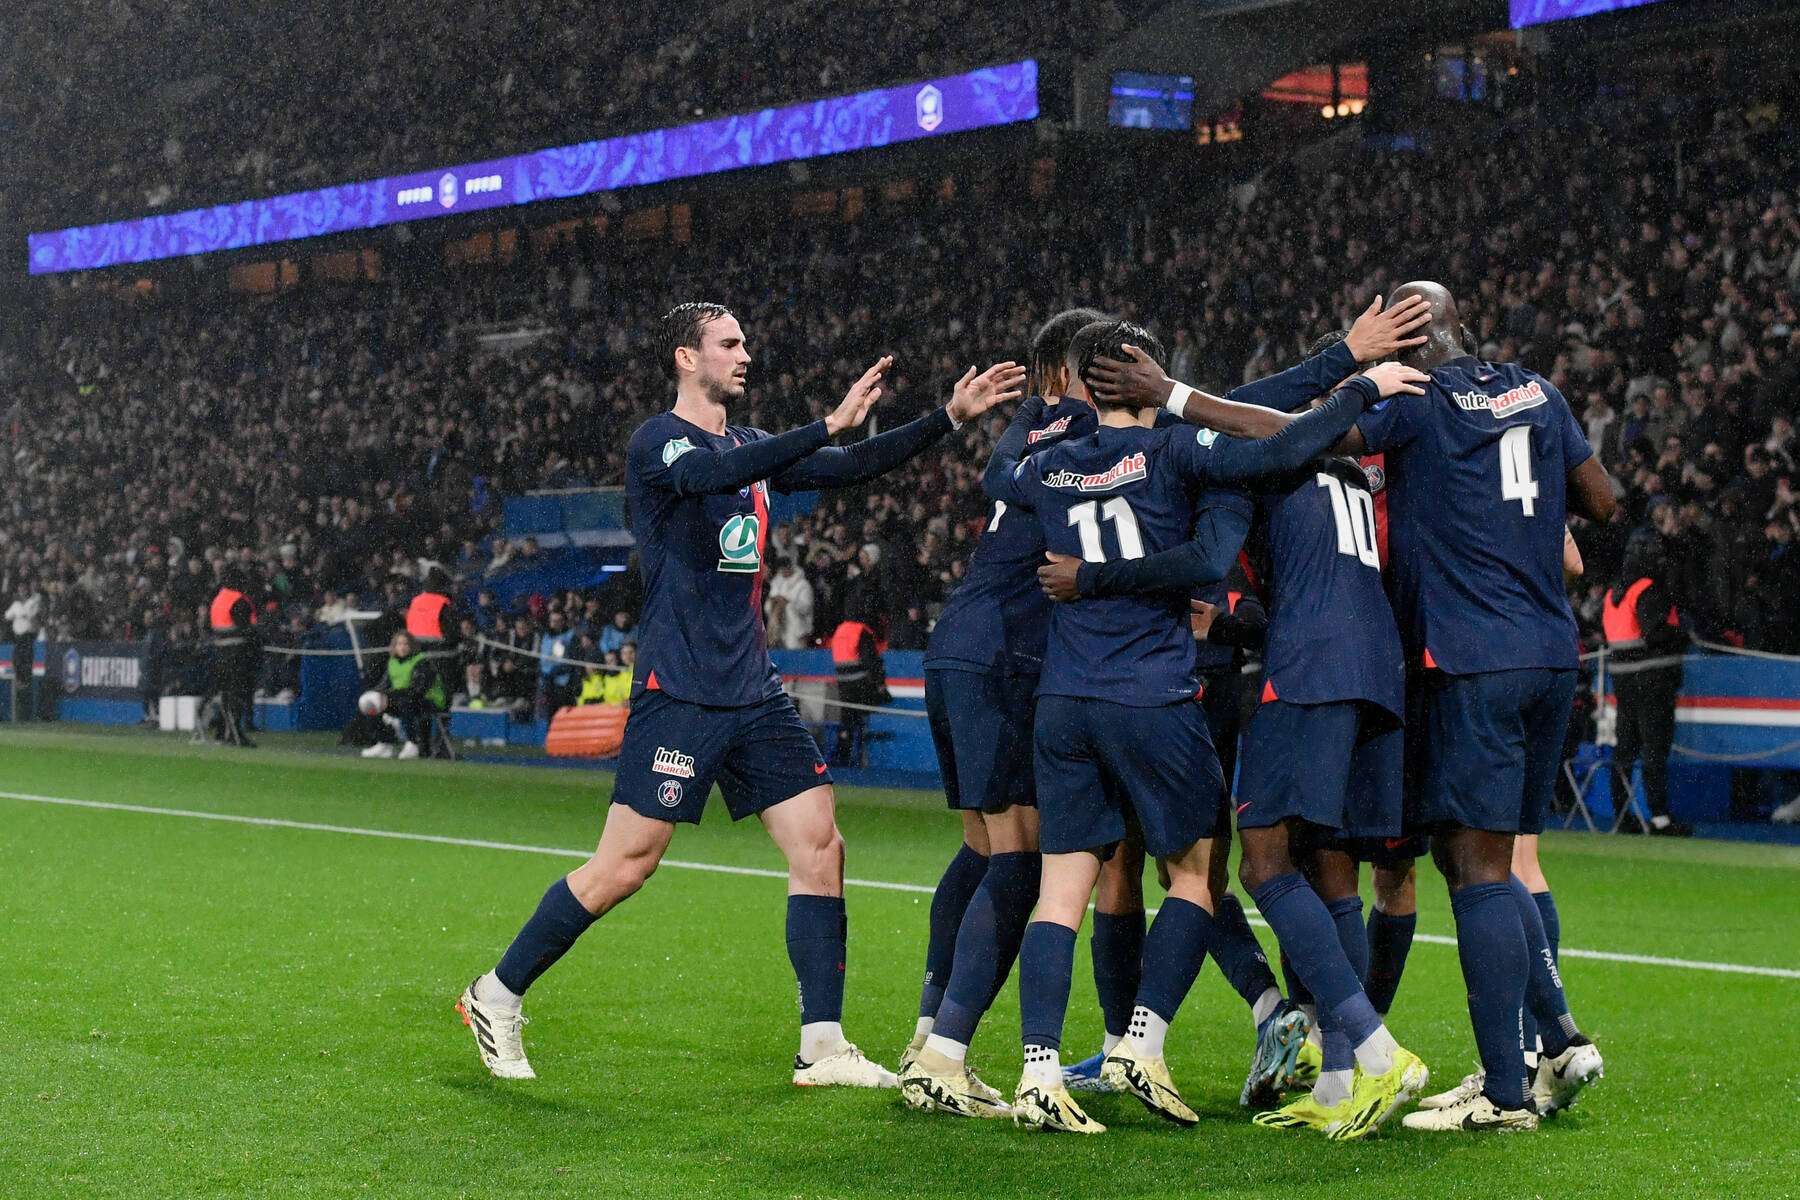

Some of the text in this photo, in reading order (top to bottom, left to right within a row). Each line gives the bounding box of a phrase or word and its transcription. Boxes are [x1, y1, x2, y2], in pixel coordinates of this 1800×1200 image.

[1500, 426, 1538, 517] 4
[1067, 496, 1145, 563] 11
[1317, 472, 1381, 573] 10
[1541, 948, 1563, 988] PARIS
